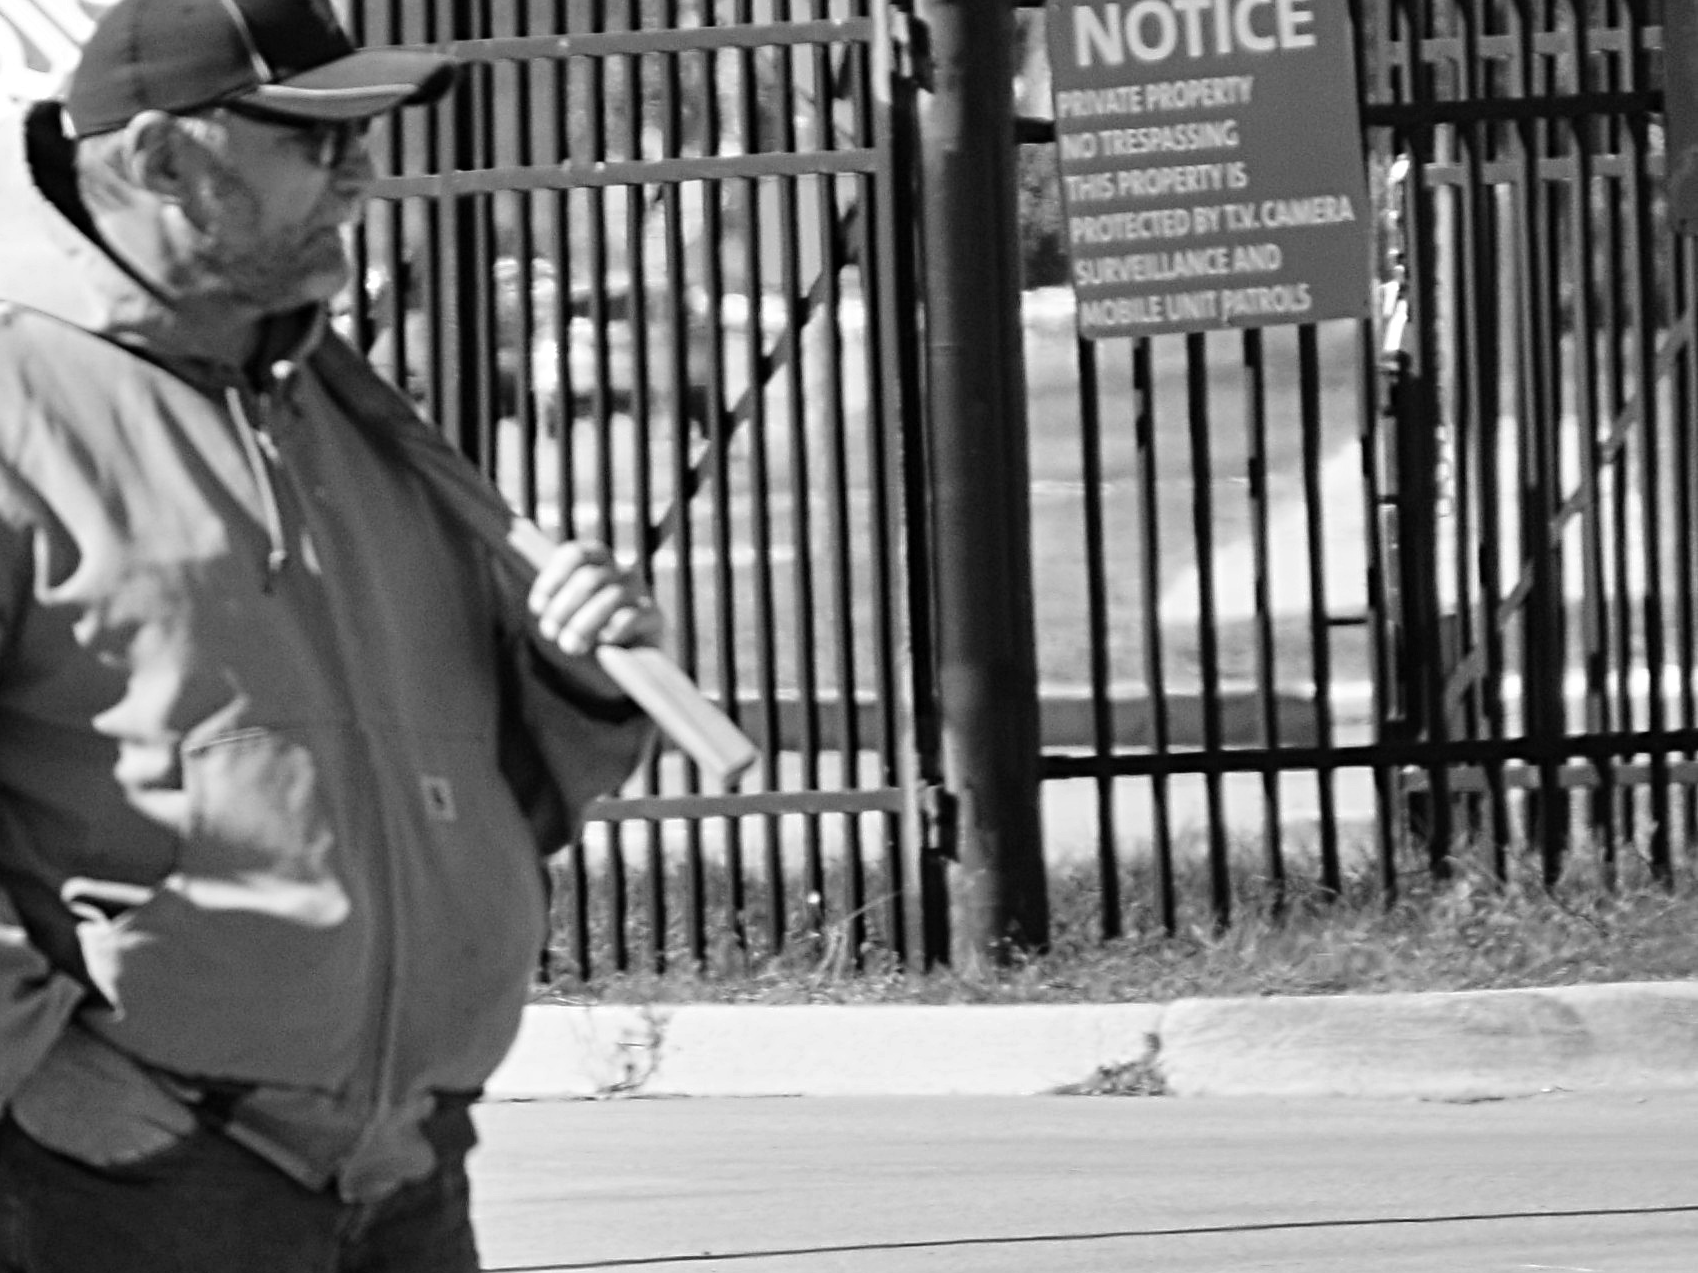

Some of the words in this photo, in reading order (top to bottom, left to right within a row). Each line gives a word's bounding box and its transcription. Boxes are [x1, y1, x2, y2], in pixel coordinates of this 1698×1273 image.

[1057, 85, 1144, 118] PRIVATE
[1145, 75, 1254, 111] PROPERTY
[1060, 132, 1097, 160] NO
[1099, 119, 1240, 155] TRESPASSING
[1064, 171, 1114, 201] THIS
[1117, 163, 1224, 197] PROPERTY
[1227, 161, 1249, 190] IS
[1069, 208, 1191, 243] PROTECTED
[1192, 205, 1221, 235] BY
[1260, 195, 1356, 228] CAMERA
[1074, 245, 1231, 286] SURVEILLANCE
[1232, 243, 1283, 274] AND
[1080, 295, 1164, 328] MOBILE
[1165, 289, 1218, 321] UNIT
[1219, 282, 1313, 325] PATROLS
